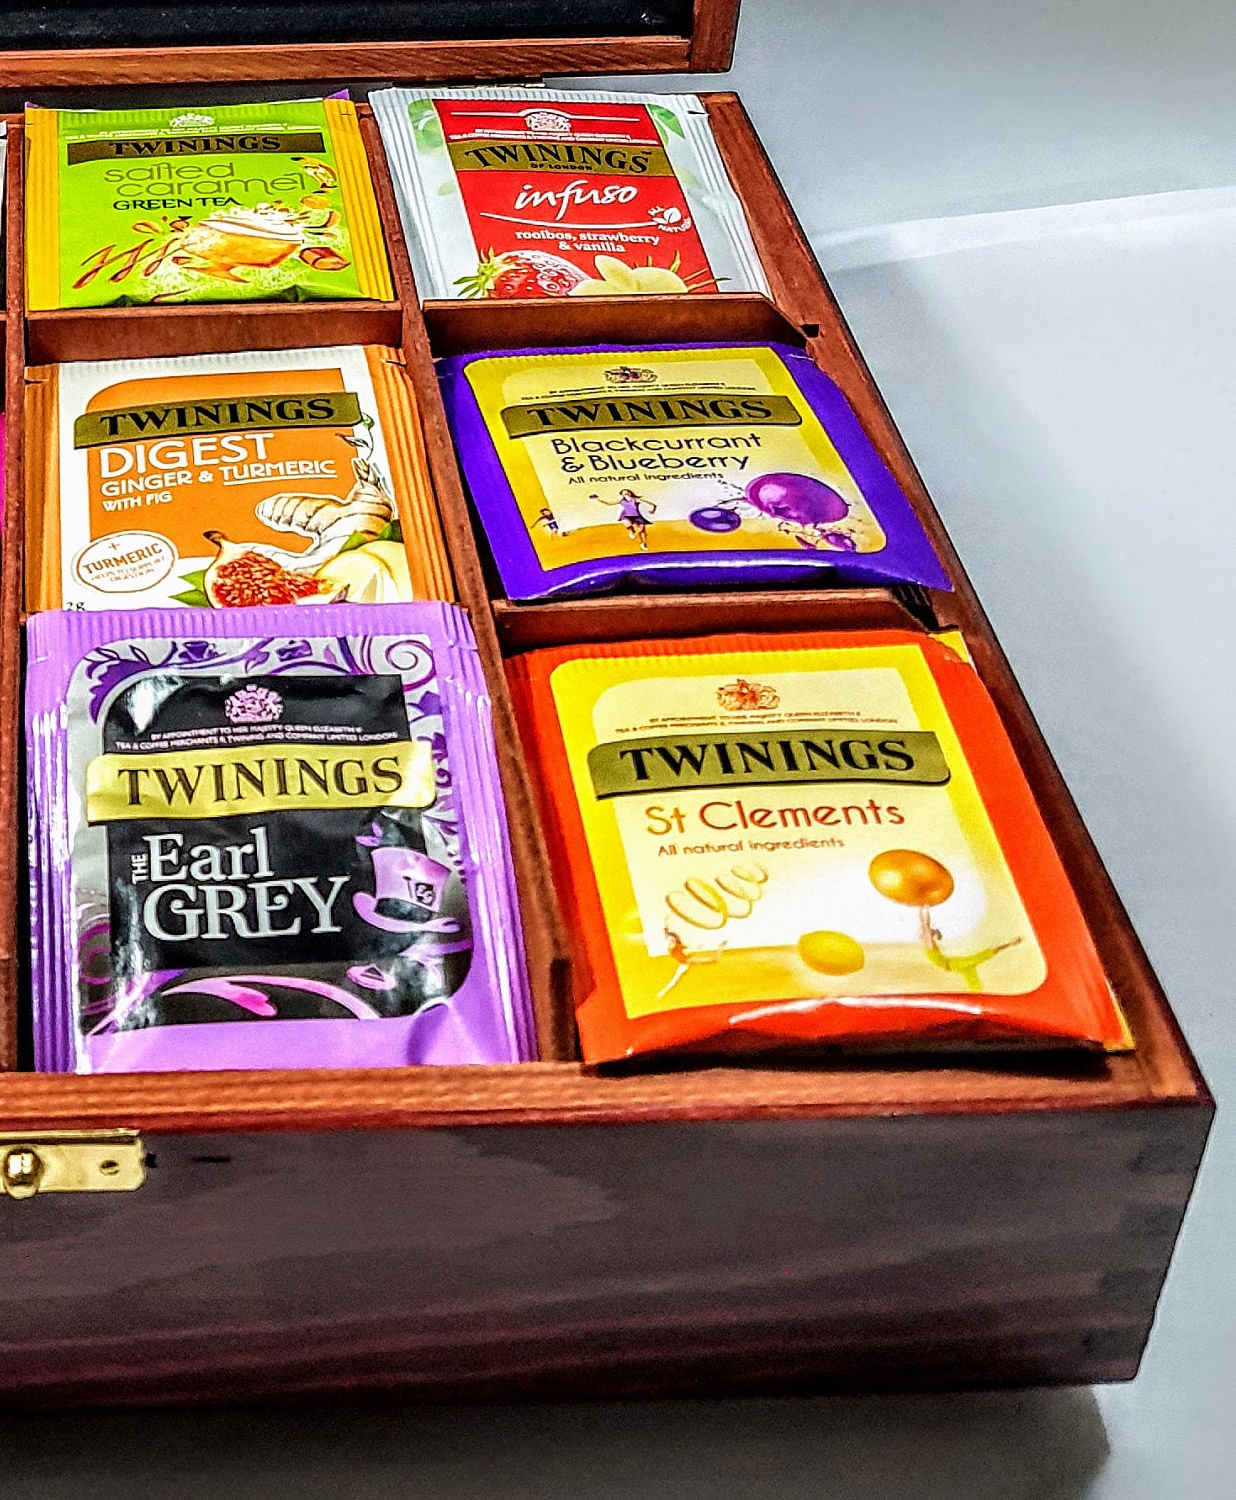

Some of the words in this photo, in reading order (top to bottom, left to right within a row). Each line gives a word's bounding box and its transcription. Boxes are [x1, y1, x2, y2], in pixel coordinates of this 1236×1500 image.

[109, 135, 281, 156] TWININGS
[465, 143, 651, 174] TWININGS
[103, 161, 236, 184] salted
[116, 172, 306, 198] caramel
[113, 197, 194, 211] GREEN
[195, 196, 243, 209] TEA
[515, 179, 638, 221] infuso
[515, 229, 577, 242] rooibos,
[579, 231, 661, 247] strawberry
[558, 241, 572, 250] &
[573, 241, 626, 253] vanilla
[100, 398, 334, 437] TWININGS
[527, 398, 772, 427] TWININGS
[99, 432, 274, 479] DIGEST
[551, 433, 762, 456] Blackcurrant
[100, 470, 193, 498] GINGER
[198, 469, 214, 483] &
[222, 459, 337, 480] TURMERIC
[560, 456, 585, 473] &
[589, 454, 750, 472] Blueberry
[568, 476, 586, 486] All
[588, 473, 640, 484] natural
[643, 471, 724, 483] ingredients
[102, 494, 142, 513] WITH
[145, 490, 173, 506] FIG
[83, 542, 163, 574] TURMERIC
[620, 739, 915, 781] TWININGS
[117, 755, 403, 807] TWININGS
[645, 805, 687, 836] St
[698, 798, 906, 831] Clements
[142, 825, 275, 882] Earl
[658, 843, 678, 857] All
[682, 838, 744, 855] natural
[748, 836, 845, 853] ingredients
[130, 852, 148, 886] THE
[142, 875, 352, 942] GREY
